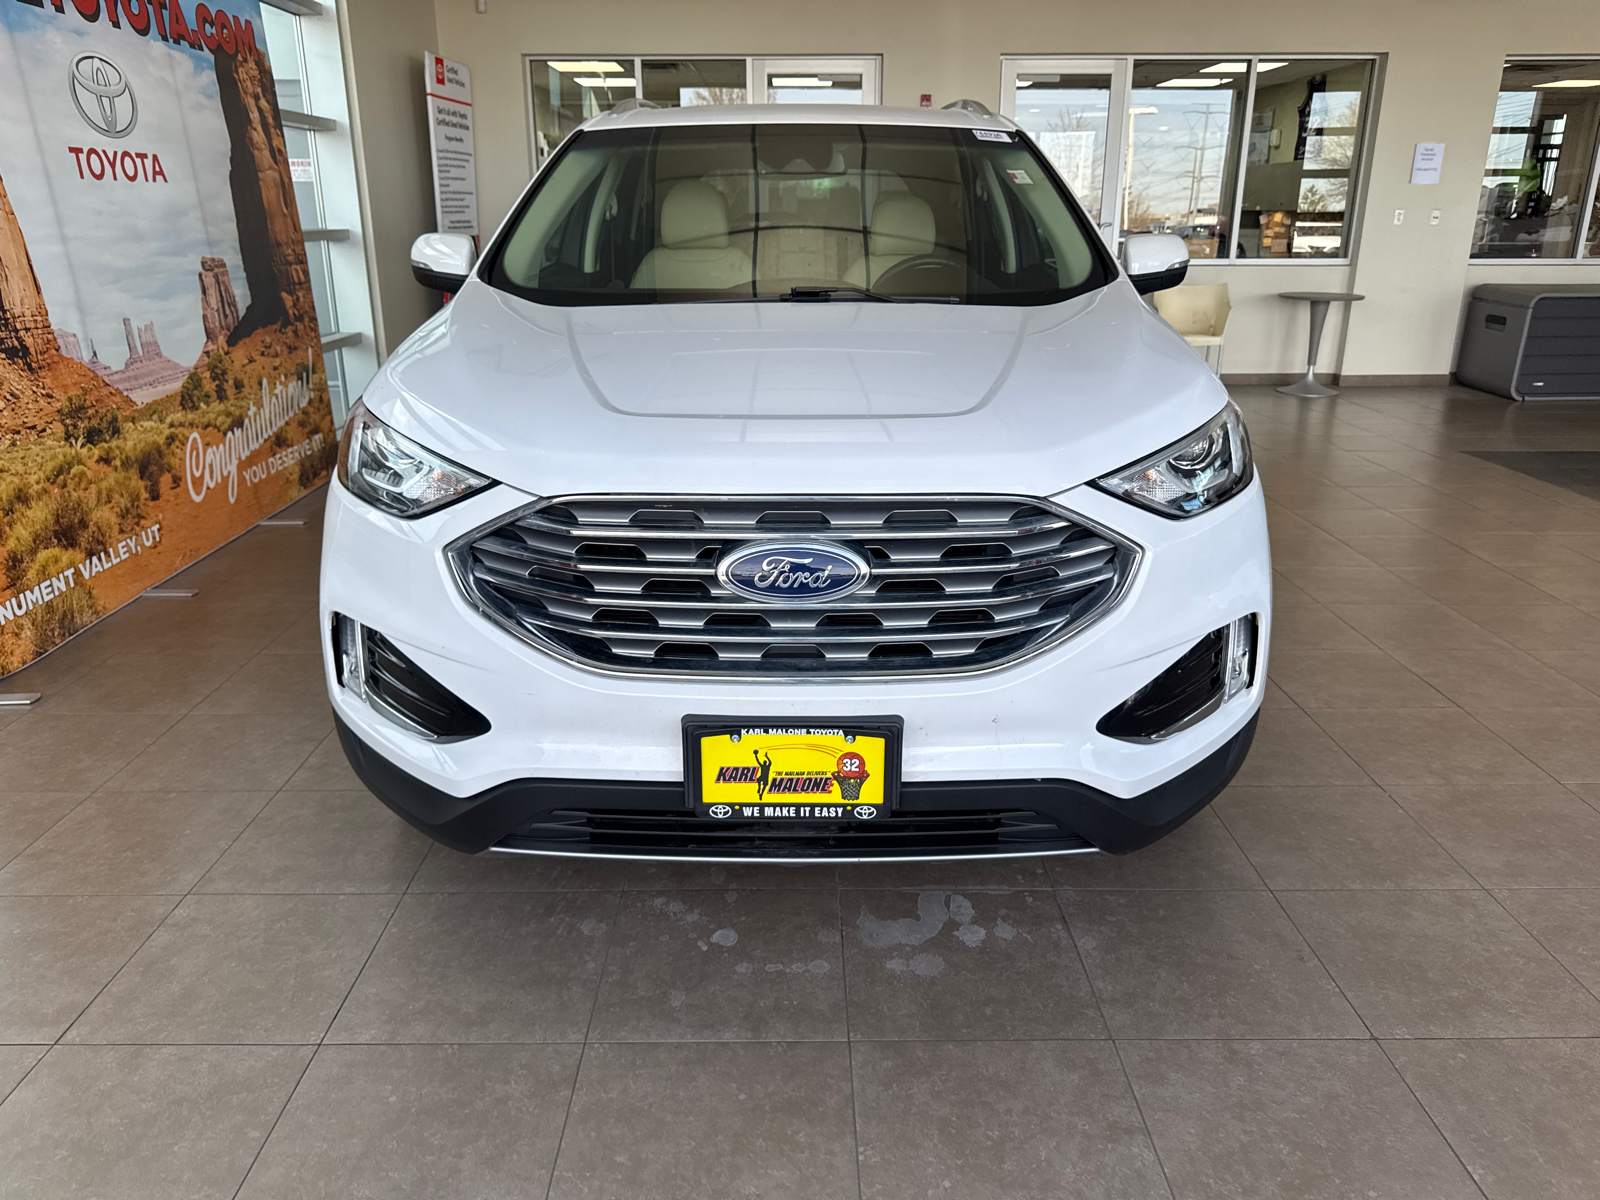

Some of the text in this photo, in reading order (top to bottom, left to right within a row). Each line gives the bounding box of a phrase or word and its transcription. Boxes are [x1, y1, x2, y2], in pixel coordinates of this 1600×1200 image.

[68, 146, 168, 183] TOYOTA
[186, 348, 314, 504] Congratulations!
[243, 432, 325, 486] YOU DESERVE IT!
[0, 523, 160, 626] NUMENT VALLEY, UT
[754, 556, 833, 588] Ford
[809, 729, 845, 737] TOYOTA
[715, 766, 760, 783] KARL
[842, 758, 860, 772] 32
[767, 777, 834, 794] MALONE
[743, 806, 843, 817] WE MAKE IT EASY
